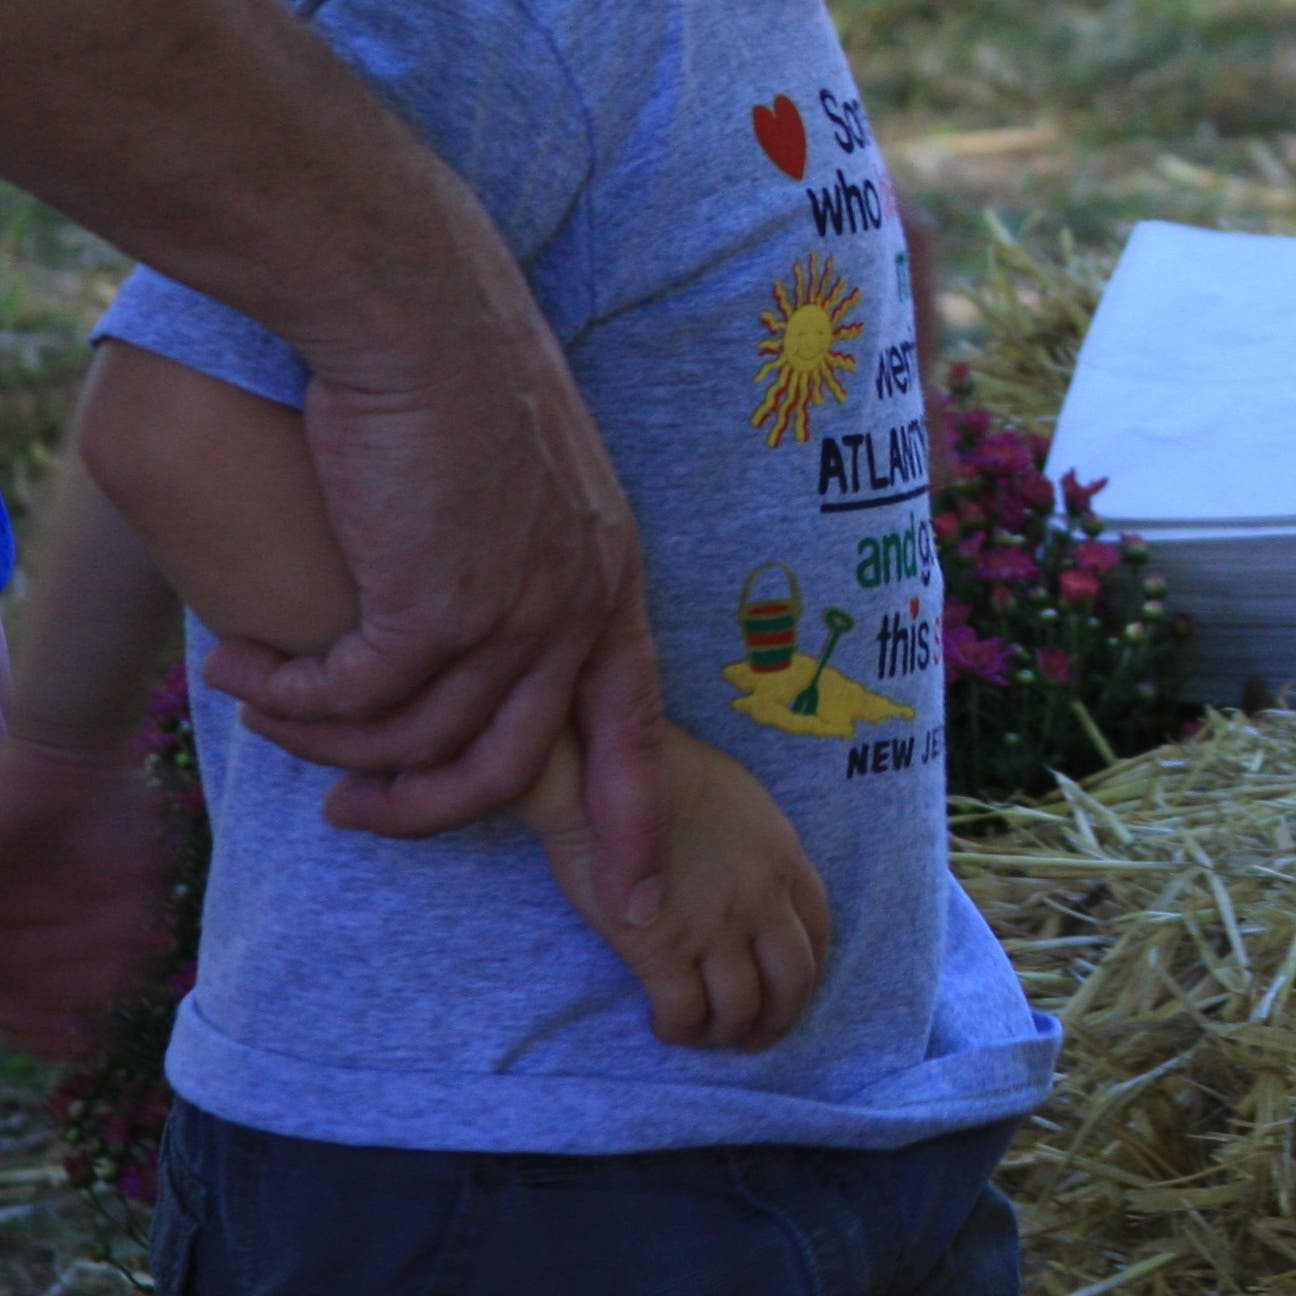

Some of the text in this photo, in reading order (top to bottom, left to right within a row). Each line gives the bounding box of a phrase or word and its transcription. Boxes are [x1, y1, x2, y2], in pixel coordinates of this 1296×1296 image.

[806, 168, 882, 237] who
[856, 511, 918, 588] and
[876, 597, 930, 680] this
[847, 736, 915, 779] NEW
